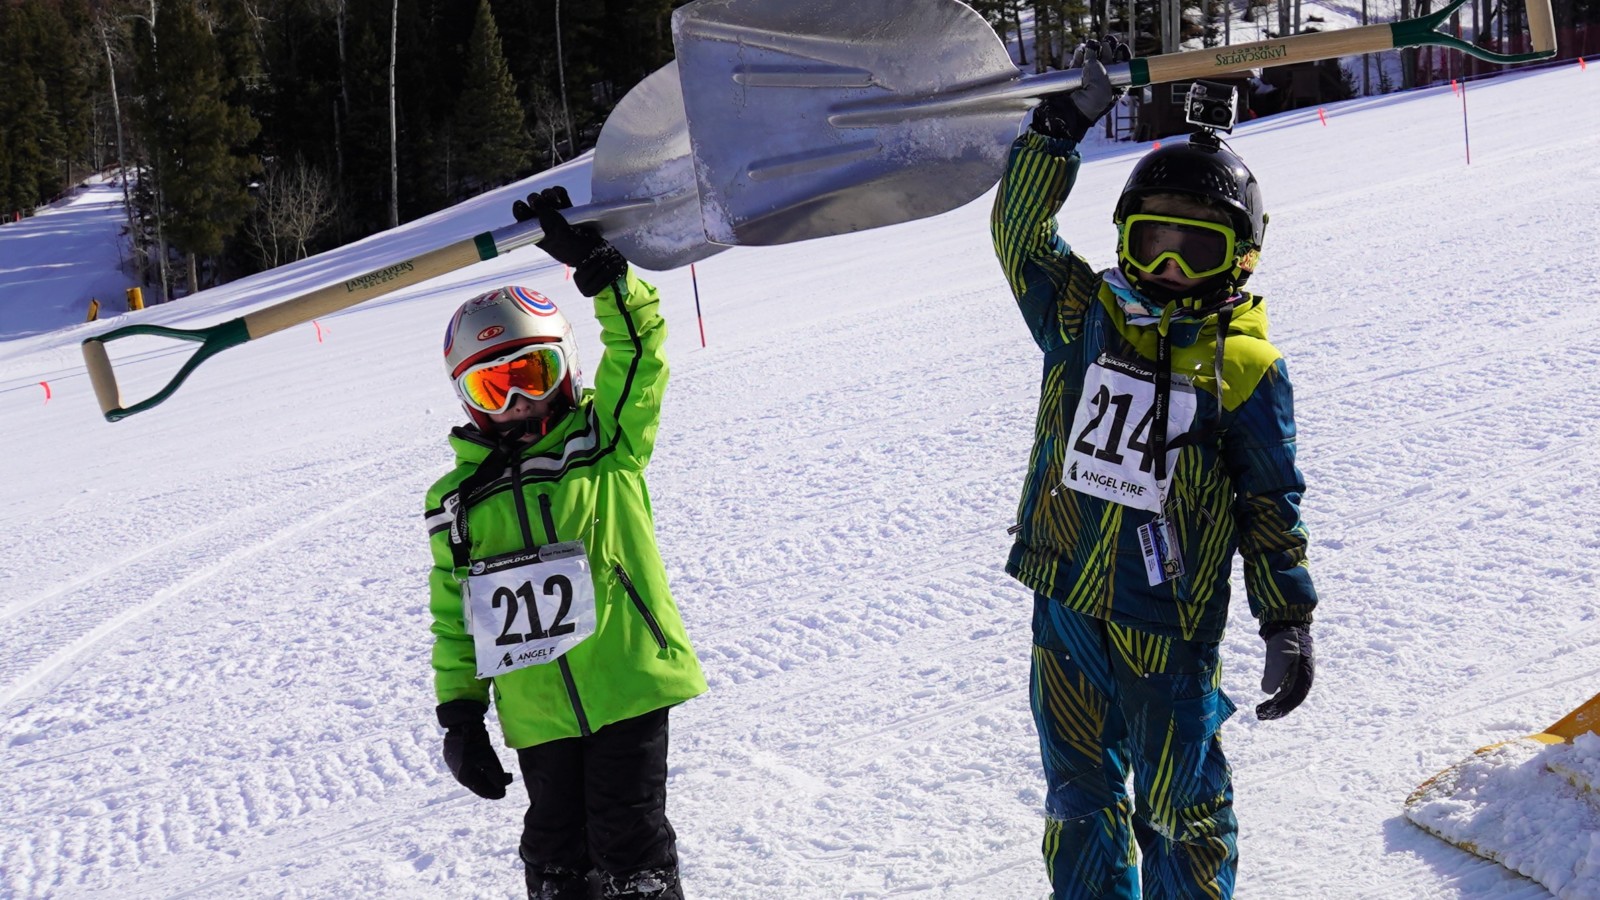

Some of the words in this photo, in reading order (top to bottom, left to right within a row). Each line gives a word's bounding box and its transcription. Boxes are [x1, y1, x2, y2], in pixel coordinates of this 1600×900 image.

[1215, 44, 1287, 66] LANDSCAPERS
[345, 260, 414, 292] LANDSCAPERS
[1073, 384, 1155, 473] 214
[1081, 470, 1118, 489] ANGEL
[1120, 481, 1146, 497] FIRE
[491, 574, 576, 647] 212
[517, 648, 548, 661] ANGEL
